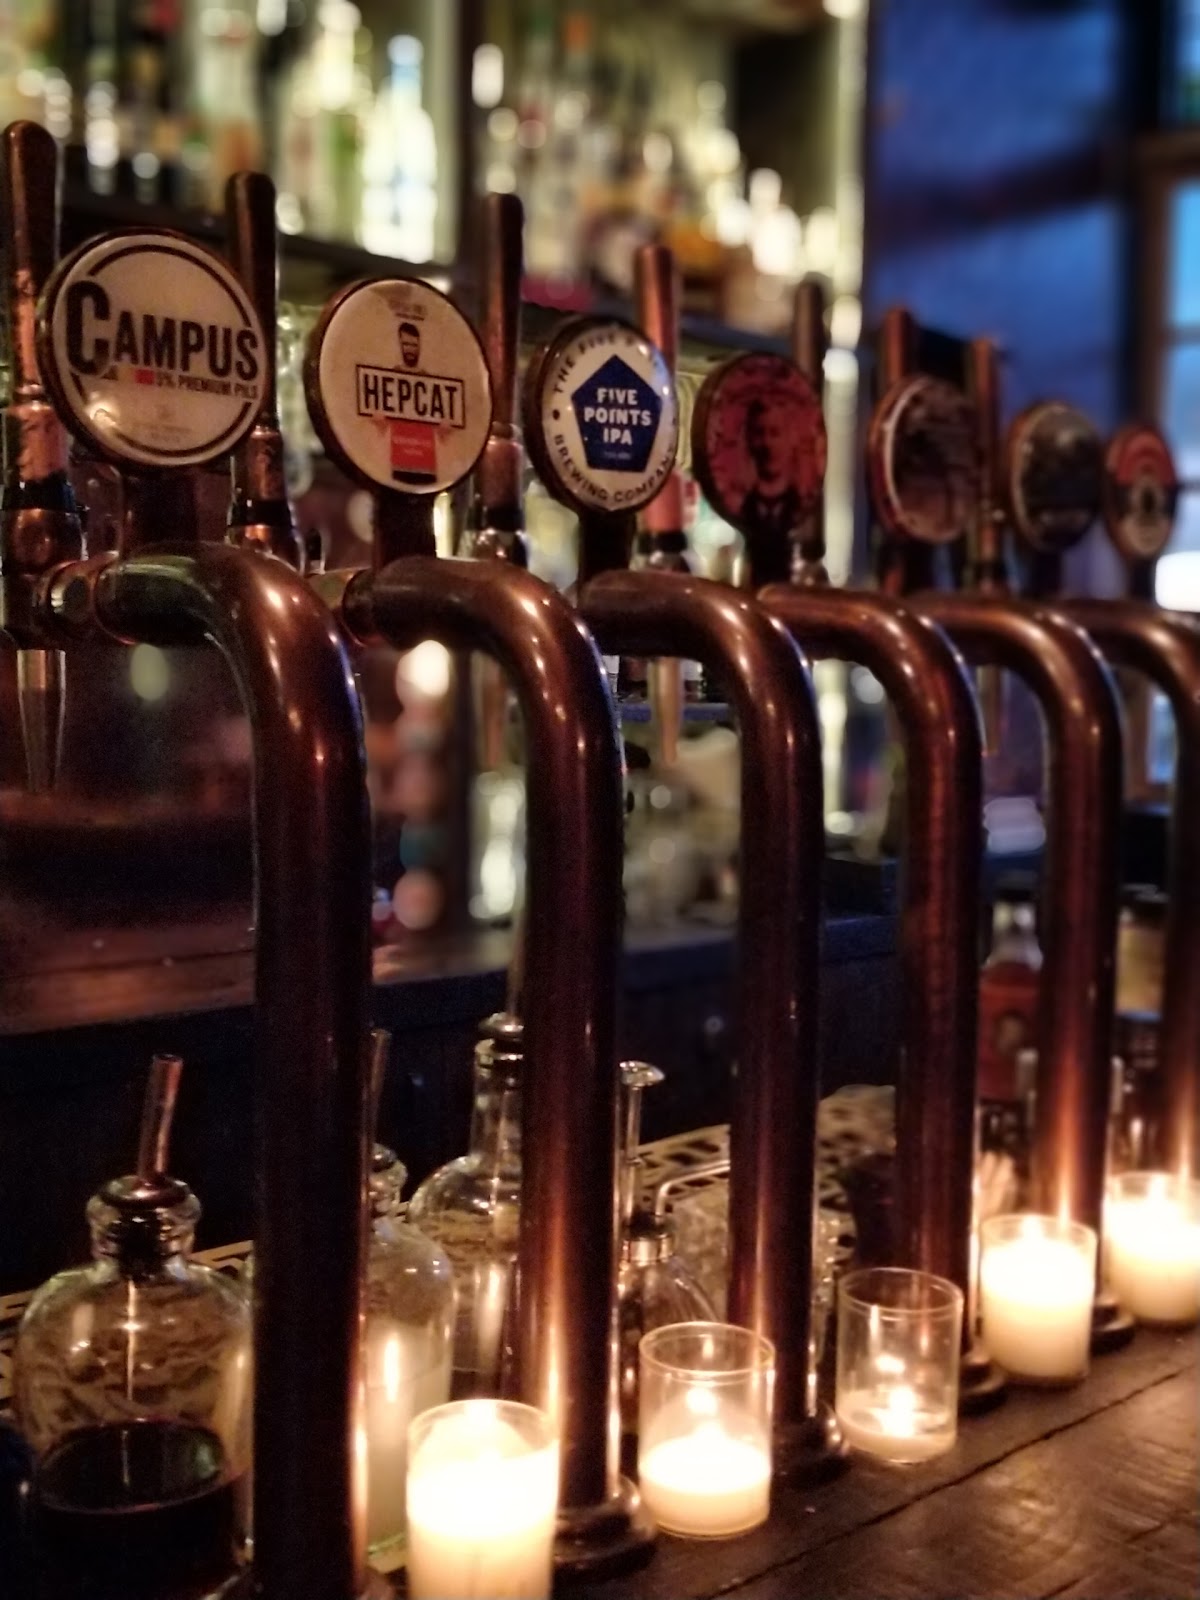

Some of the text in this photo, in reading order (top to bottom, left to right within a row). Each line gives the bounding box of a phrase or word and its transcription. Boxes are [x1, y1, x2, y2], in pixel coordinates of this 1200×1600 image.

[66, 280, 259, 381] CAMPUS
[553, 356, 576, 393] THE
[364, 373, 458, 420] HEPCAT
[596, 387, 639, 406] FIVE
[583, 406, 653, 427] POINTS
[603, 428, 633, 446] IPA
[553, 434, 609, 501] BREWING
